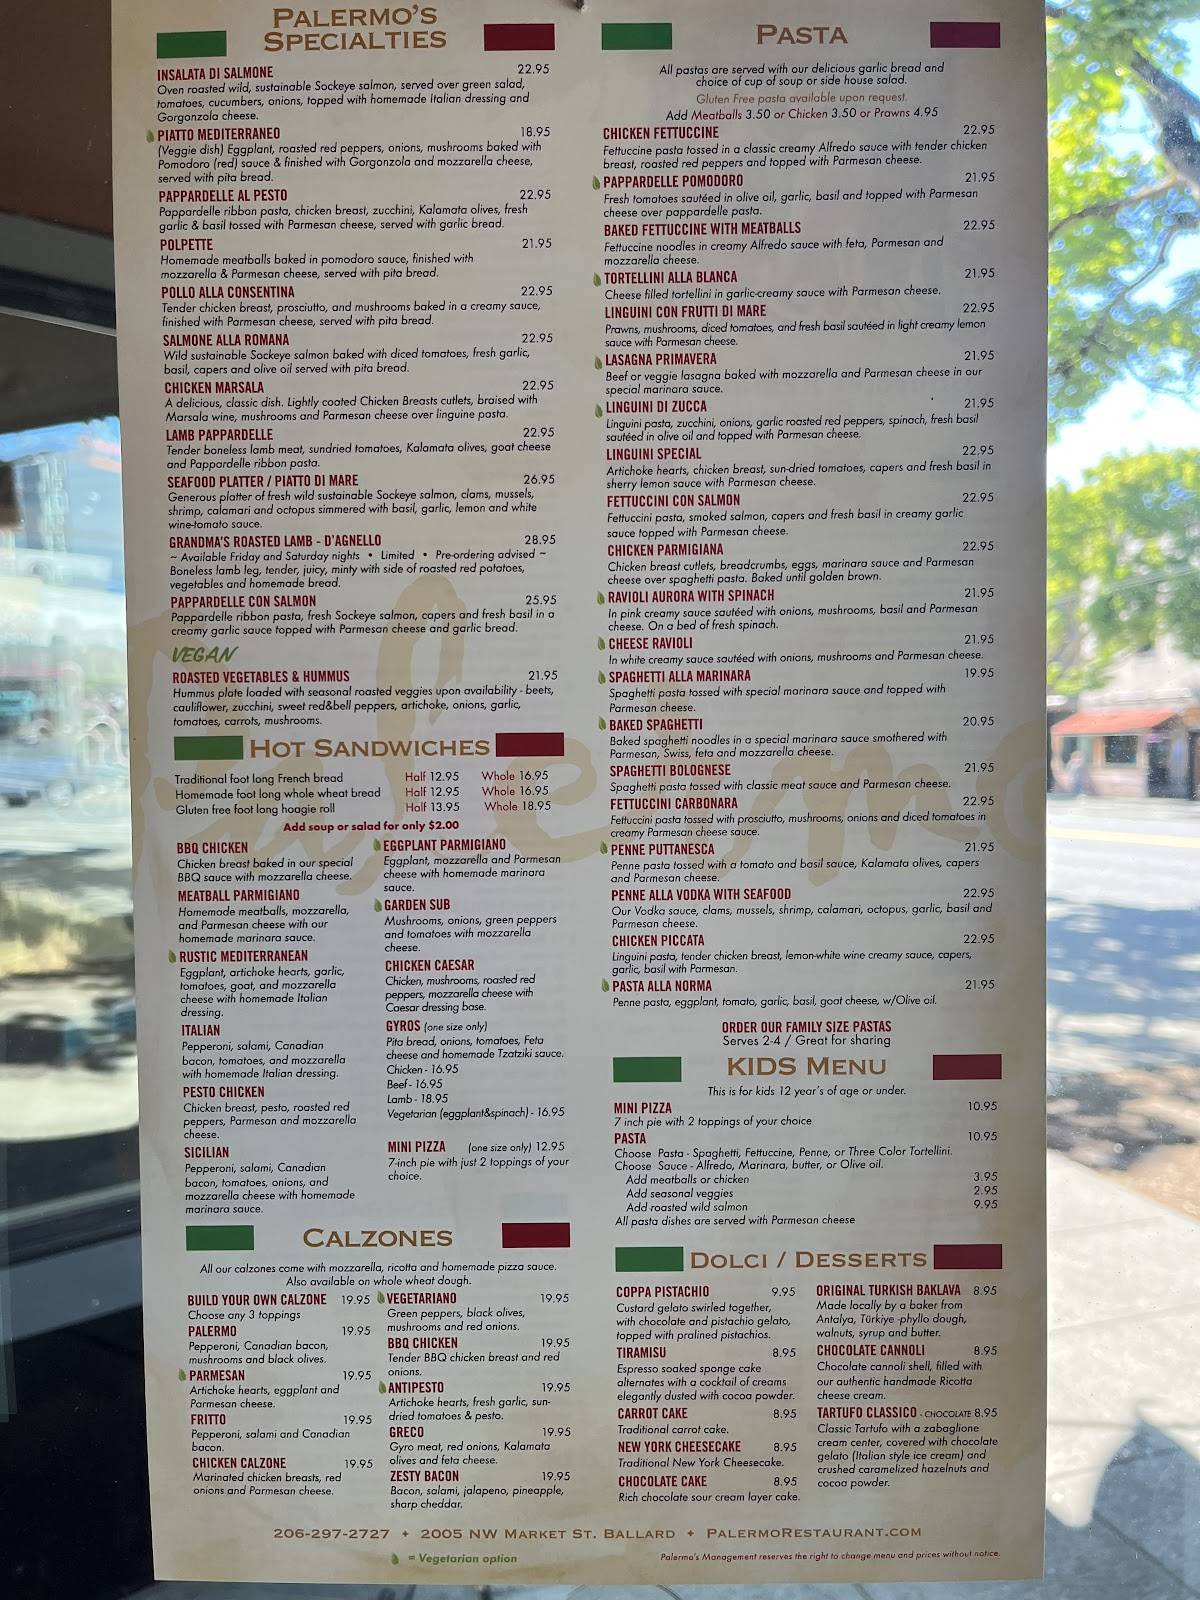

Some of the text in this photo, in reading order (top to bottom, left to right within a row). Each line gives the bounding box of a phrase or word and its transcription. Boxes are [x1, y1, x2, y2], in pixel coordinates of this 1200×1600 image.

[157, 66, 274, 82] INSALATA DI SALMONE
[518, 64, 549, 74] 22.95
[697, 93, 729, 104] Gluten
[734, 94, 754, 103] Free
[758, 95, 786, 106] pasta
[790, 91, 836, 103] available
[840, 96, 865, 104] upon
[158, 127, 280, 142] PIATTO MEDITERRANEO
[521, 127, 550, 137] 18.95
[603, 126, 719, 140] CHICKEN FETTUCCINE
[964, 124, 995, 135] 22.95
[160, 241, 195, 251] POLPETTE
[522, 238, 552, 249] 21.95
[605, 305, 766, 319] LINGUINI CON FRUTTI DI MARE
[963, 302, 995, 313] 22.95
[163, 334, 290, 347] SALMONE ALLA ROMANA
[522, 333, 553, 343] 22.95
[606, 353, 717, 366] LASAGNA PRIMAVERA
[965, 350, 995, 361] 21.95
[165, 381, 264, 394] CHICKEN MARSALA
[523, 380, 554, 391] 22.95
[606, 384, 641, 397] special
[644, 385, 689, 394] marinara
[608, 543, 724, 557] CHICKEN PARMIGIANA
[963, 541, 994, 551] 22.95
[609, 637, 692, 650] CHEESE RAVIOLI
[965, 634, 994, 644] 21.95
[172, 646, 239, 663] VEGAN
[174, 714, 322, 727] tomatoes, carrots, mushrooms.
[610, 718, 703, 731] BAKED SPAGHETTI
[963, 716, 994, 726] 20.95
[174, 772, 343, 786] Traditional foot long French bread
[406, 771, 459, 782] Half 12.95
[482, 770, 548, 781] Whole 16.95
[610, 782, 656, 794] Spaghetti
[660, 783, 686, 793] pasta
[690, 780, 721, 791] tossed
[724, 780, 743, 790] with
[747, 780, 778, 790] classic
[781, 781, 806, 790] meat
[840, 779, 860, 789] and
[863, 779, 911, 789] Parmesan
[914, 778, 952, 790] cheese.
[283, 822, 306, 832] Add
[308, 825, 334, 834] soup
[352, 821, 381, 831] salad
[383, 821, 400, 830] for
[402, 821, 426, 832] only
[429, 820, 459, 831] $2.00
[177, 842, 248, 855] BBQ CHICKEN
[383, 838, 506, 852] EGGPLANT PARMIGIANO
[612, 843, 715, 856] PENNE PUTTANESCA
[965, 842, 995, 852] 21.95
[613, 980, 712, 992] PASTA ALLA NORMA
[965, 980, 995, 990] 21.95
[386, 1020, 487, 1033] GYROS (one size only)
[722, 1021, 892, 1033] ORDER OUR FAMILY SIZE PASTAS
[728, 1057, 797, 1076] KIDS
[614, 1102, 672, 1114] MINI PIZZA
[967, 1100, 998, 1112] 10.95
[776, 1251, 786, 1268] /
[286, 1276, 307, 1286] Also
[310, 1276, 355, 1286] available
[374, 1275, 402, 1286] whole
[406, 1275, 435, 1285] wheat
[438, 1275, 472, 1288] dough.
[817, 1284, 961, 1296] ORIGINAL TURKISH BAKLAVA
[973, 1286, 997, 1296] 8.95
[387, 1292, 457, 1305] VEGETARIANO
[541, 1294, 569, 1303] 19.95
[617, 1347, 666, 1359] TIRAMISU
[773, 1348, 796, 1358] 8.95
[390, 1427, 424, 1438] GRECO
[542, 1427, 571, 1437] 19.95
[193, 1457, 286, 1469] CHICKEN CALZONE
[345, 1459, 373, 1469] 19.95
[274, 1529, 390, 1539] 206-297-2727
[421, 1529, 462, 1539] 2005
[470, 1529, 497, 1539] NW
[419, 1553, 479, 1565] Vegetarian
[482, 1554, 518, 1565] option
[702, 1553, 757, 1563] Management
[795, 1552, 807, 1560] the
[810, 1552, 829, 1562] right
[842, 1552, 872, 1562] change
[898, 1550, 914, 1559] and
[916, 1551, 941, 1561] prices
[943, 1550, 972, 1559] without
[975, 1550, 1002, 1559] notice.
